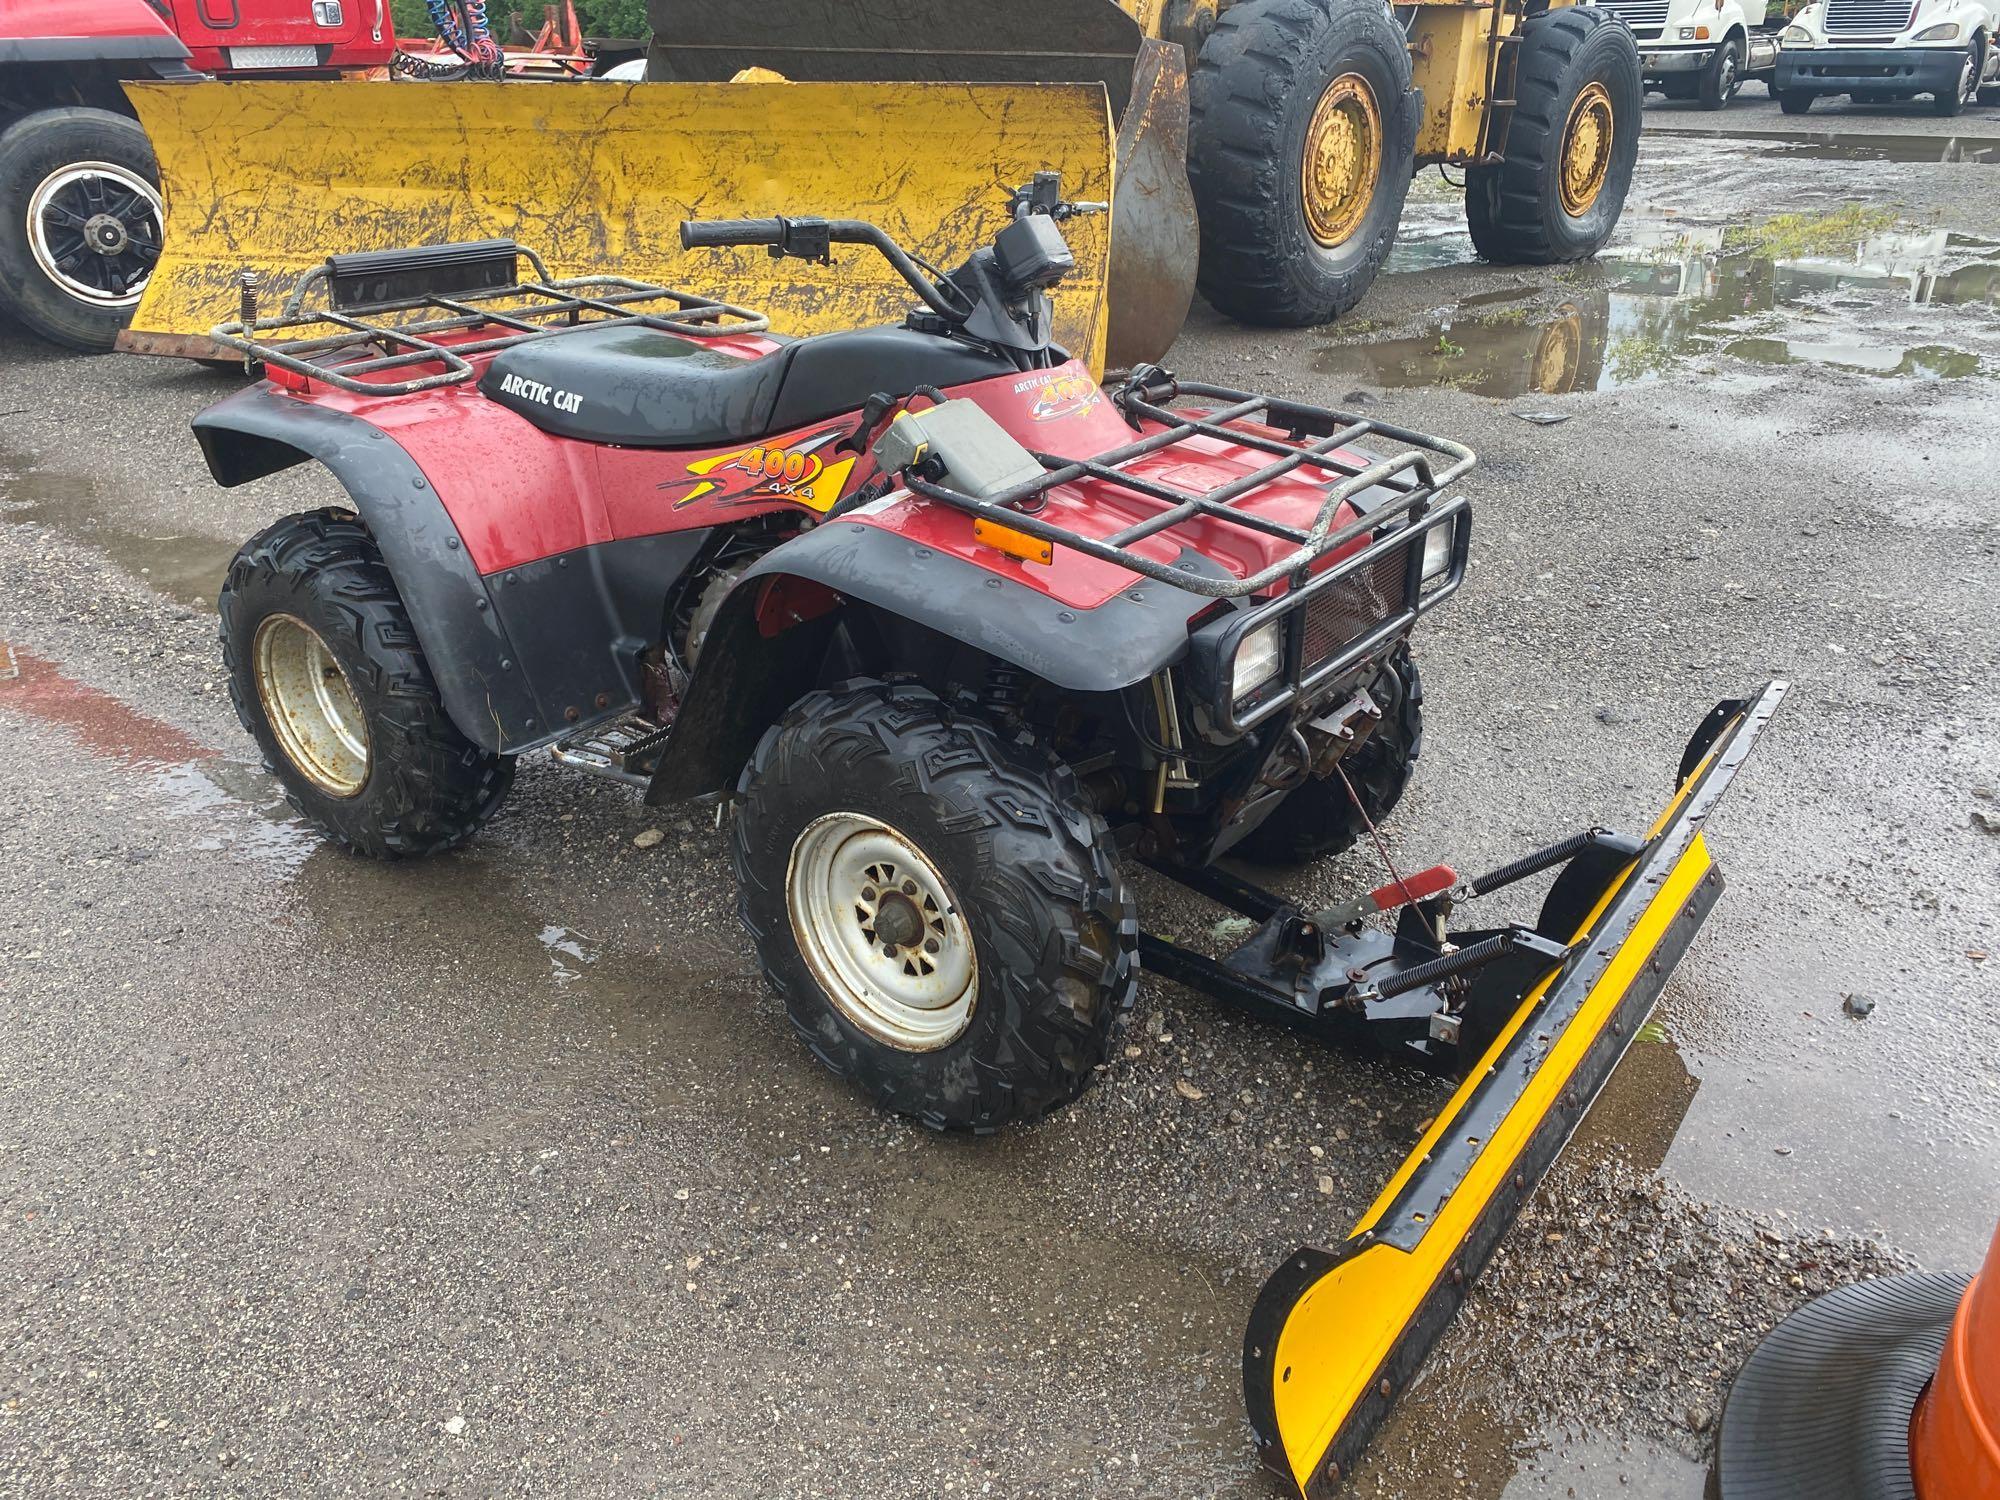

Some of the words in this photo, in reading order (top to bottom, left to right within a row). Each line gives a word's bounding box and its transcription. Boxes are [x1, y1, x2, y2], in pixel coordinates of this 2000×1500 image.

[500, 373, 553, 405] ARCTIC
[553, 390, 584, 414] CAT
[1013, 379, 1041, 394] ARCTIC
[1040, 374, 1053, 385] CAT
[736, 446, 806, 481] 400
[768, 482, 816, 500] 4X4
